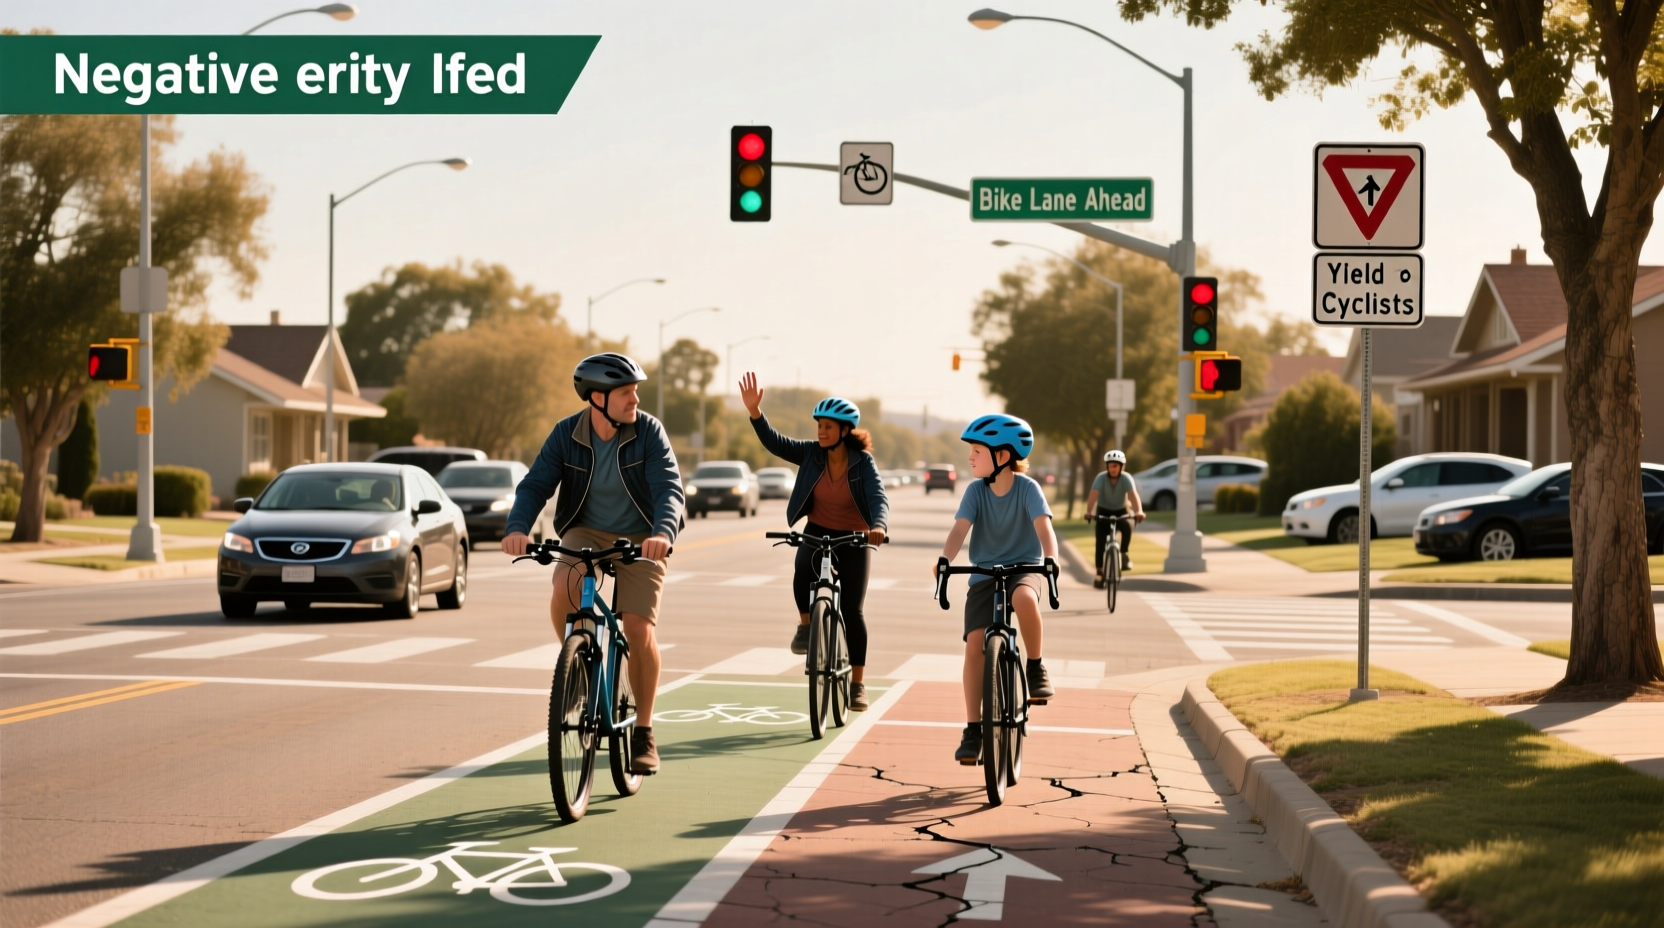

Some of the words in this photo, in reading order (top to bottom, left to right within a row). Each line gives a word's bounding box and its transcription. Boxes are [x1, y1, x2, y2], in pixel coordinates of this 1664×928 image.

[979, 187, 1022, 211] Bike
[1030, 187, 1077, 211] Lane
[1084, 187, 1146, 212] Ahead
[1327, 262, 1384, 285] Yield
[1321, 291, 1414, 320] Cyclists
